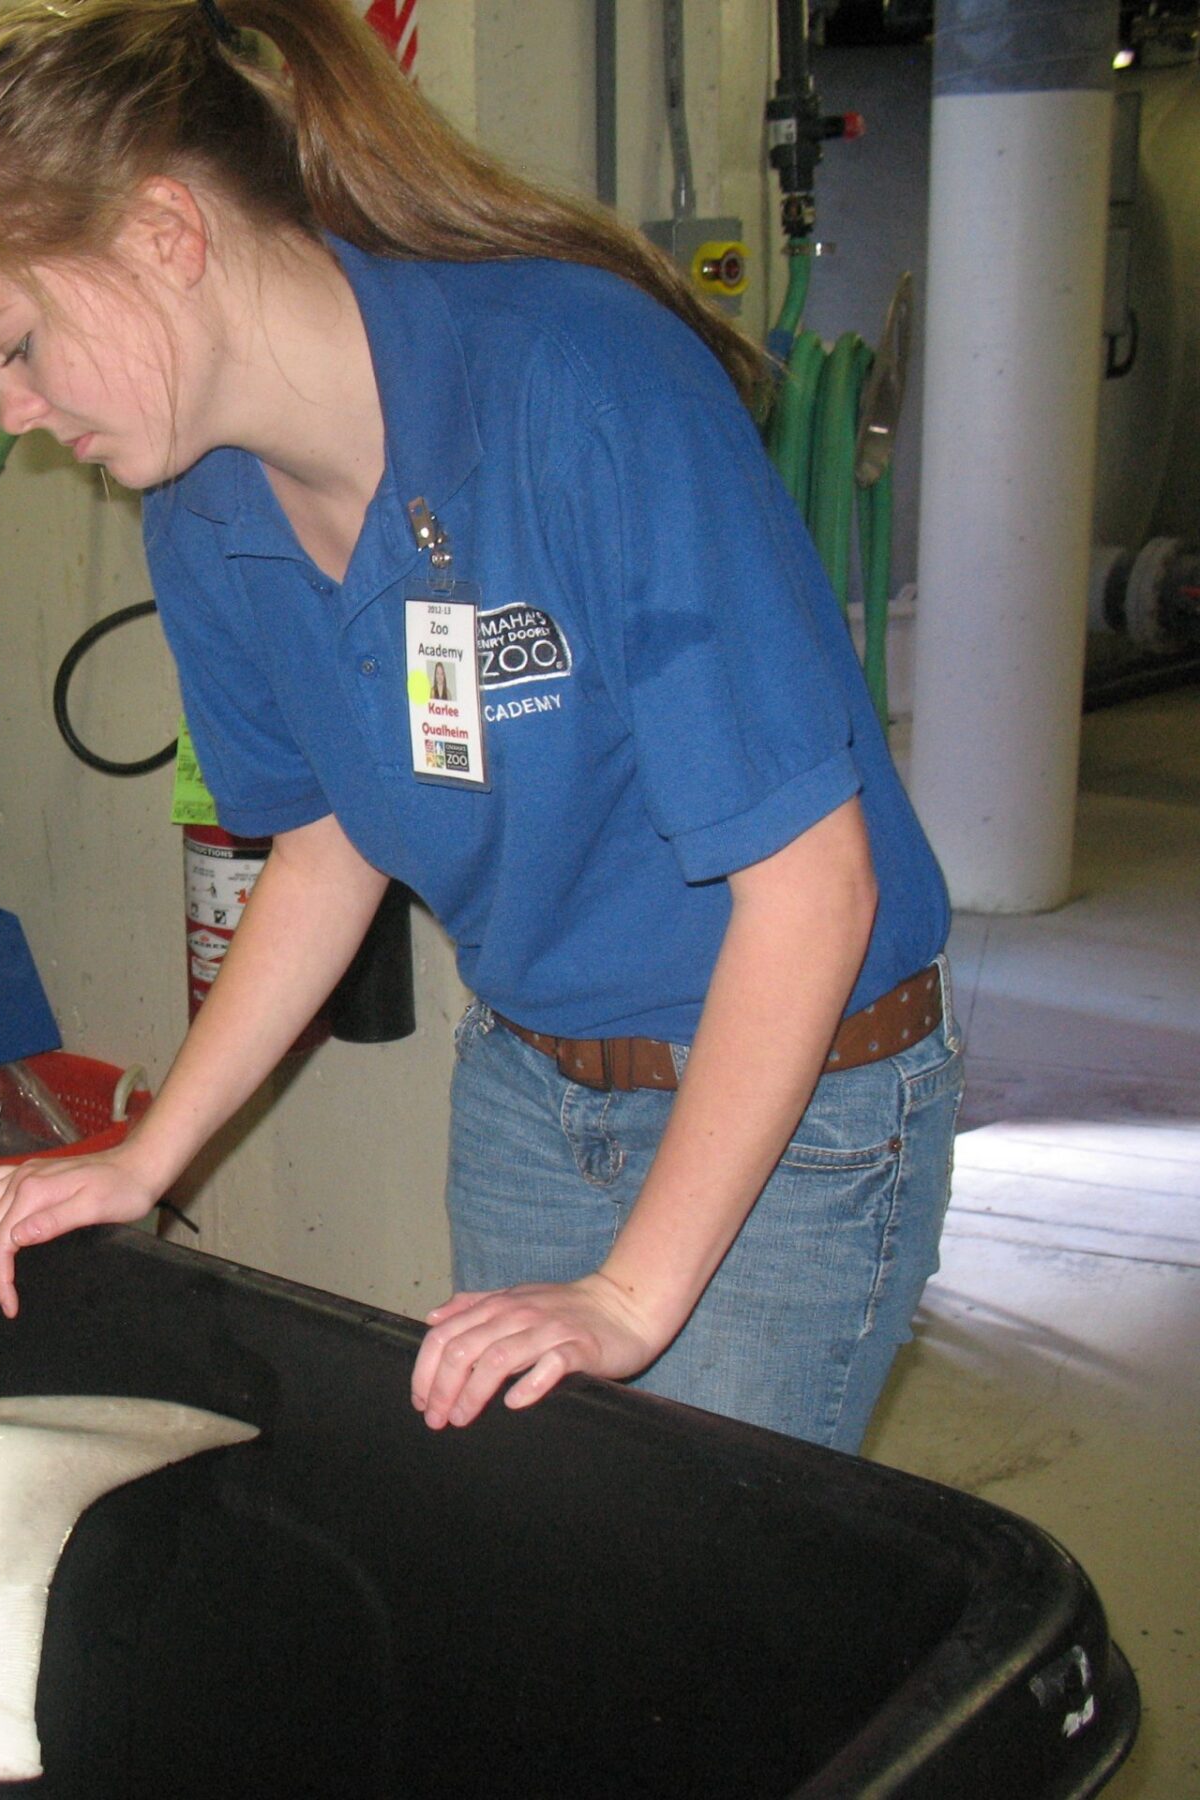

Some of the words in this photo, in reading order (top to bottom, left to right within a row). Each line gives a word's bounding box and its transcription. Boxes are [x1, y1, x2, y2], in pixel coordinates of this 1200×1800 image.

[430, 621, 449, 635] Zoo
[480, 611, 547, 637] MAHA'S
[477, 635, 505, 649] ENRY
[508, 627, 551, 642] DOORLY
[418, 642, 463, 662] Academy
[478, 640, 557, 676] ZOO
[428, 702, 459, 717] Karlee
[484, 694, 562, 722] CADEMY
[422, 723, 469, 739] Qualheim
[446, 754, 468, 766] ZOO
